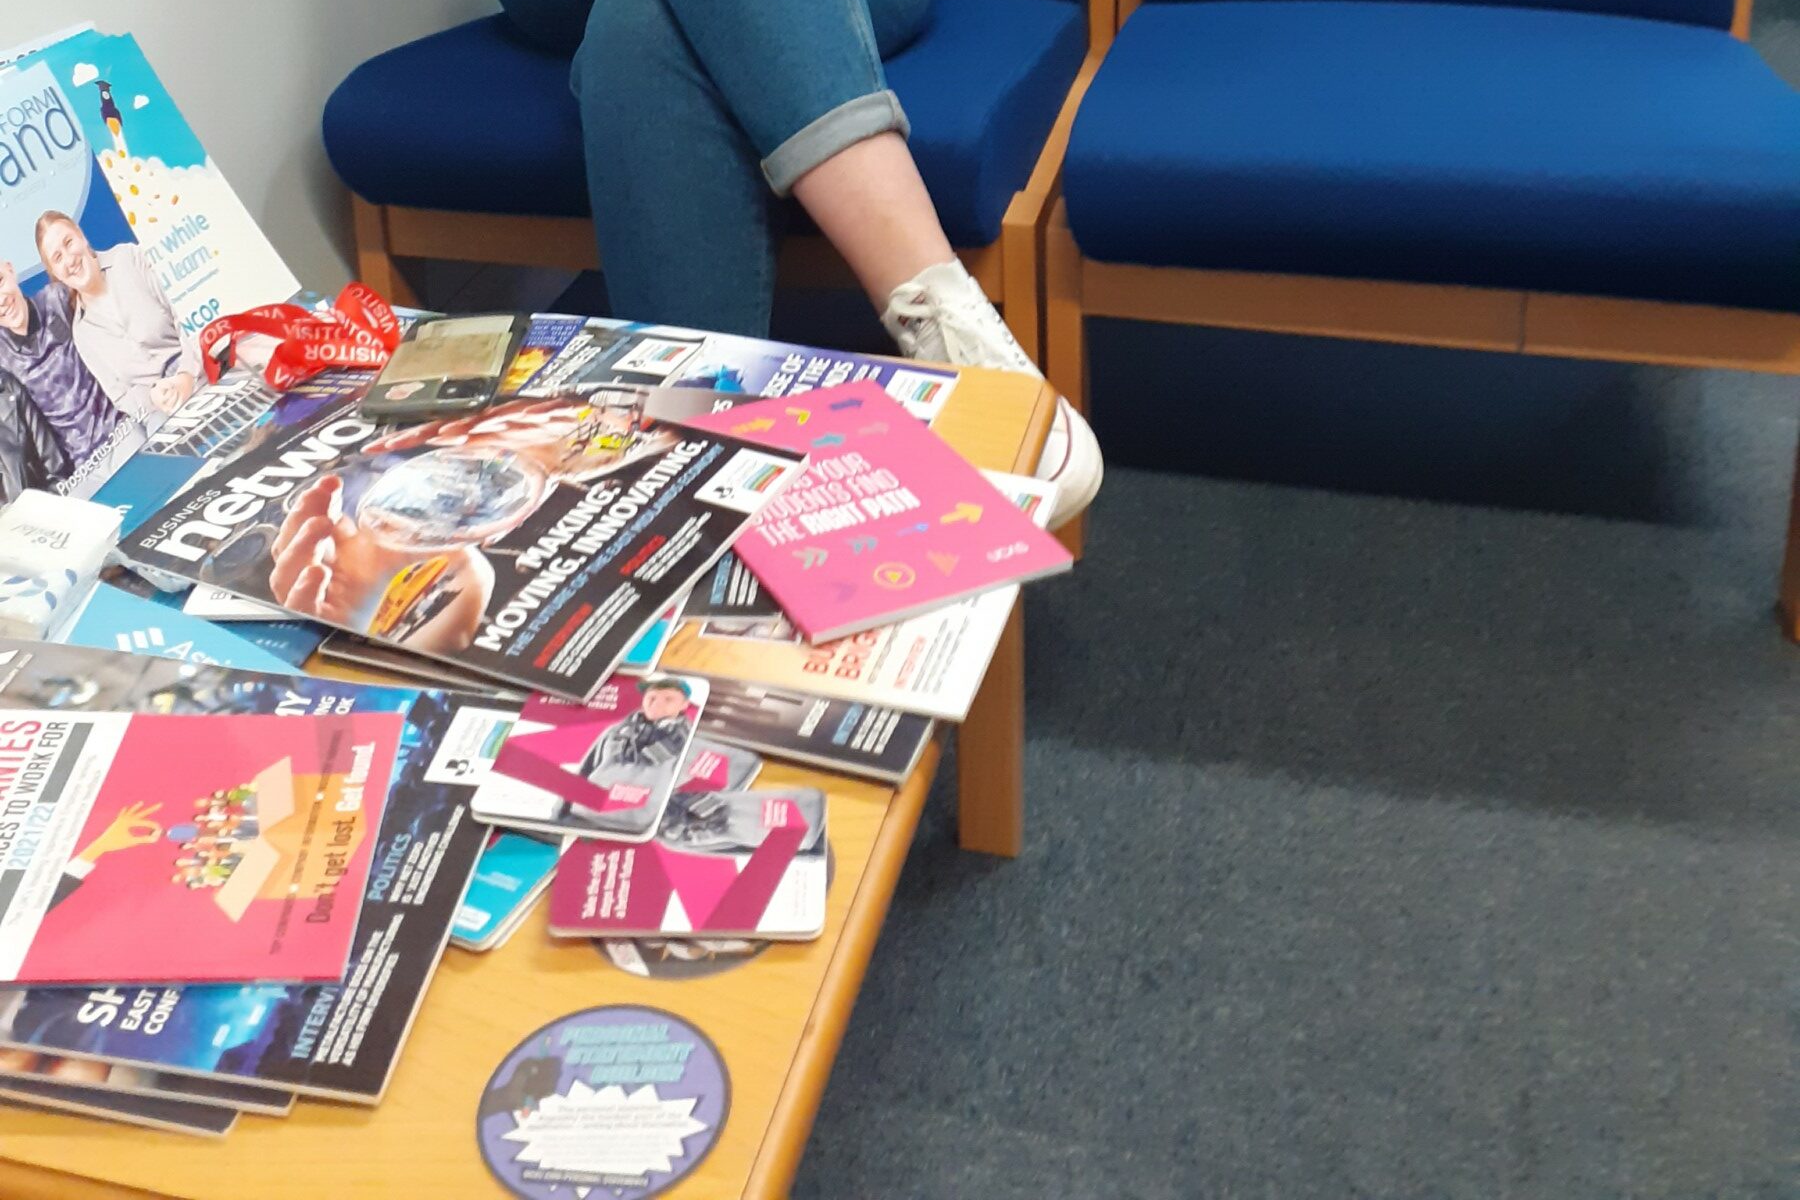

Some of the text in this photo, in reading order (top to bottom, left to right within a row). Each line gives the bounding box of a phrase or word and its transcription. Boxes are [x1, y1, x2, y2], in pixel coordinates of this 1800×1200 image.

[160, 214, 211, 254] while
[178, 297, 220, 338] NCOP
[56, 440, 113, 498] Prospectus
[140, 489, 221, 549] BUSINESS
[525, 482, 622, 570] MAKING.
[756, 487, 921, 547] THE RIGHT PATH
[474, 555, 587, 651] MOVING.
[571, 439, 709, 555] INNOVATING.
[38, 722, 68, 748] FOR
[15, 752, 54, 795] WORK
[3, 800, 31, 818] TO
[8, 804, 56, 871] 2021/22
[327, 815, 357, 848] lost.
[324, 851, 350, 878] get
[367, 833, 412, 902] POLITICS
[120, 989, 157, 1031] EAST
